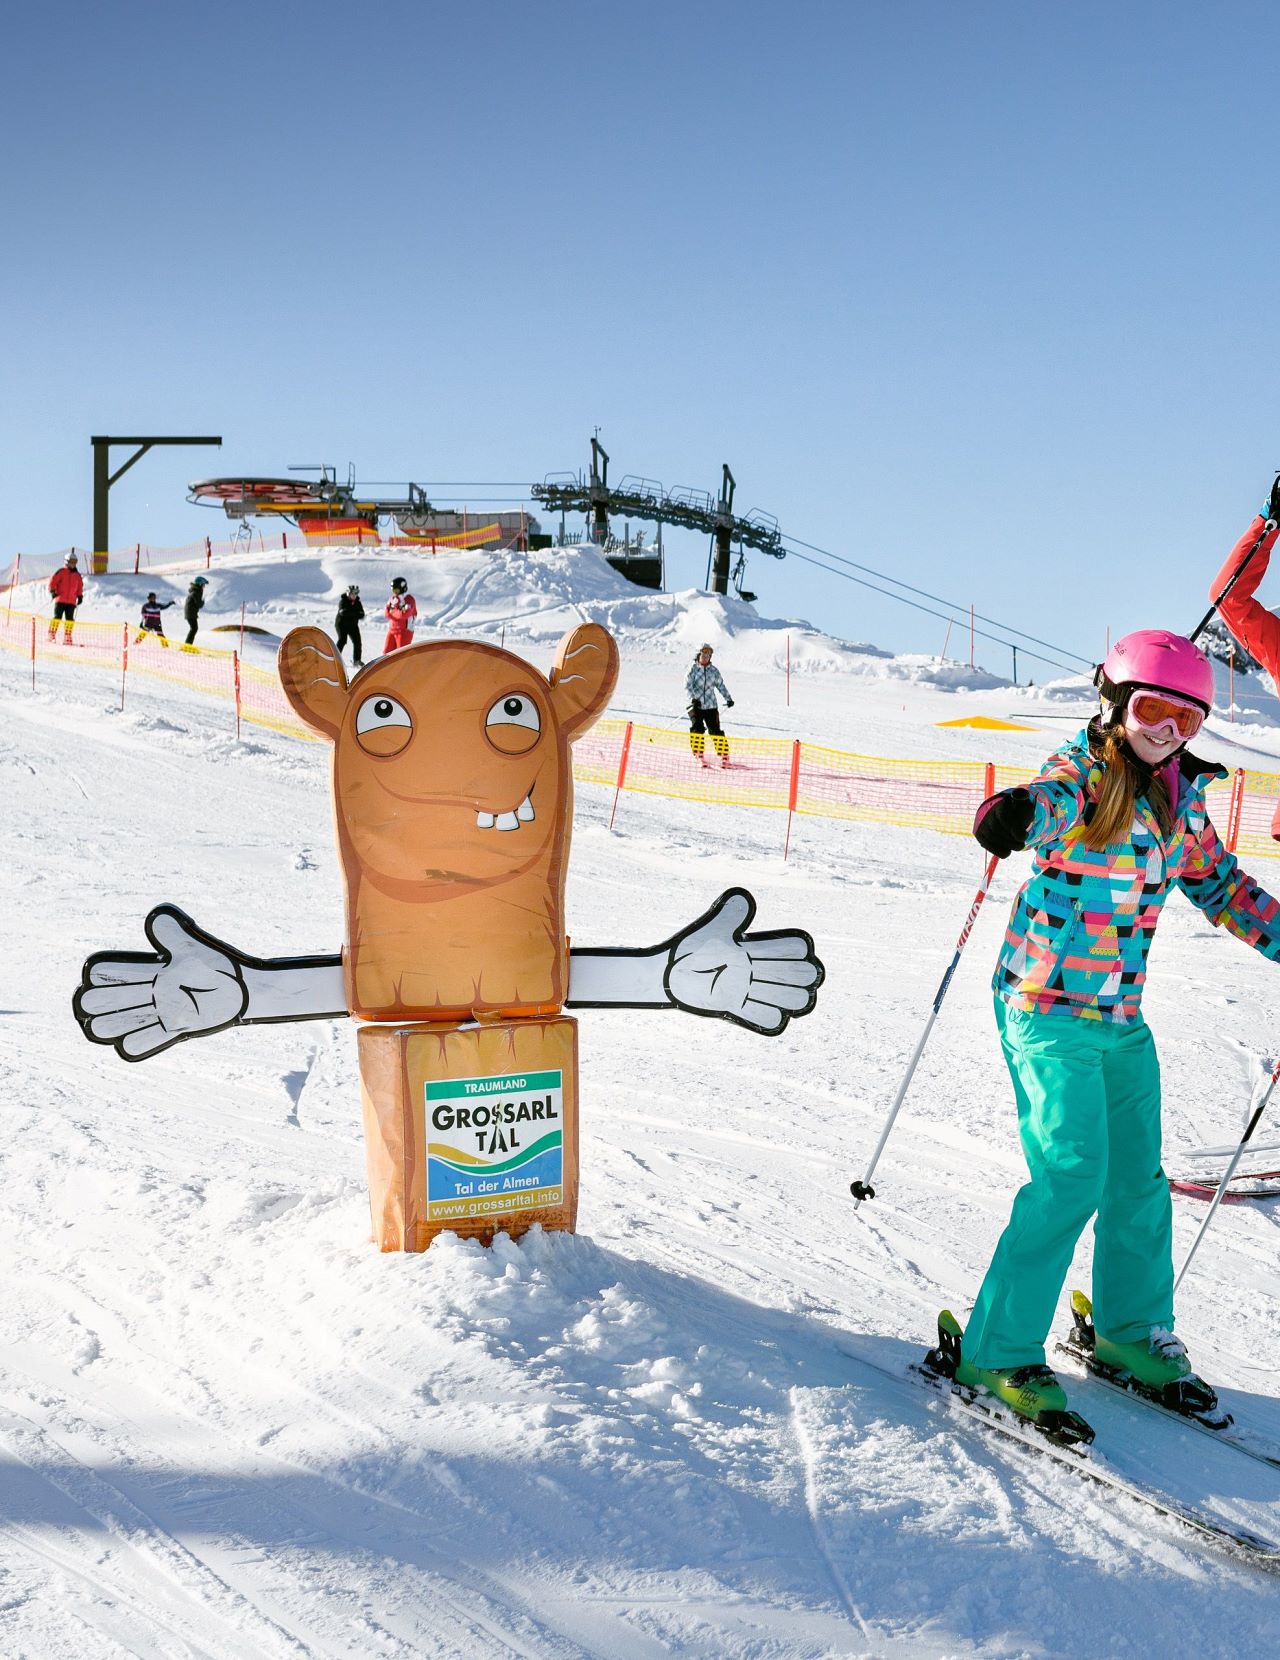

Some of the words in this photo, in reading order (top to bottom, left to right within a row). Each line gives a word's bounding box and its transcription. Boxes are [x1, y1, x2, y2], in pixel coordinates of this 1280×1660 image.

[465, 1079, 526, 1093] TRAUMLAND
[432, 1095, 558, 1130] GROSSARL
[475, 1126, 520, 1154] TAL
[455, 1182, 473, 1195] Tal
[478, 1180, 499, 1192] der
[503, 1176, 539, 1189] Almen
[432, 1191, 559, 1216] www.grossarltal.info
